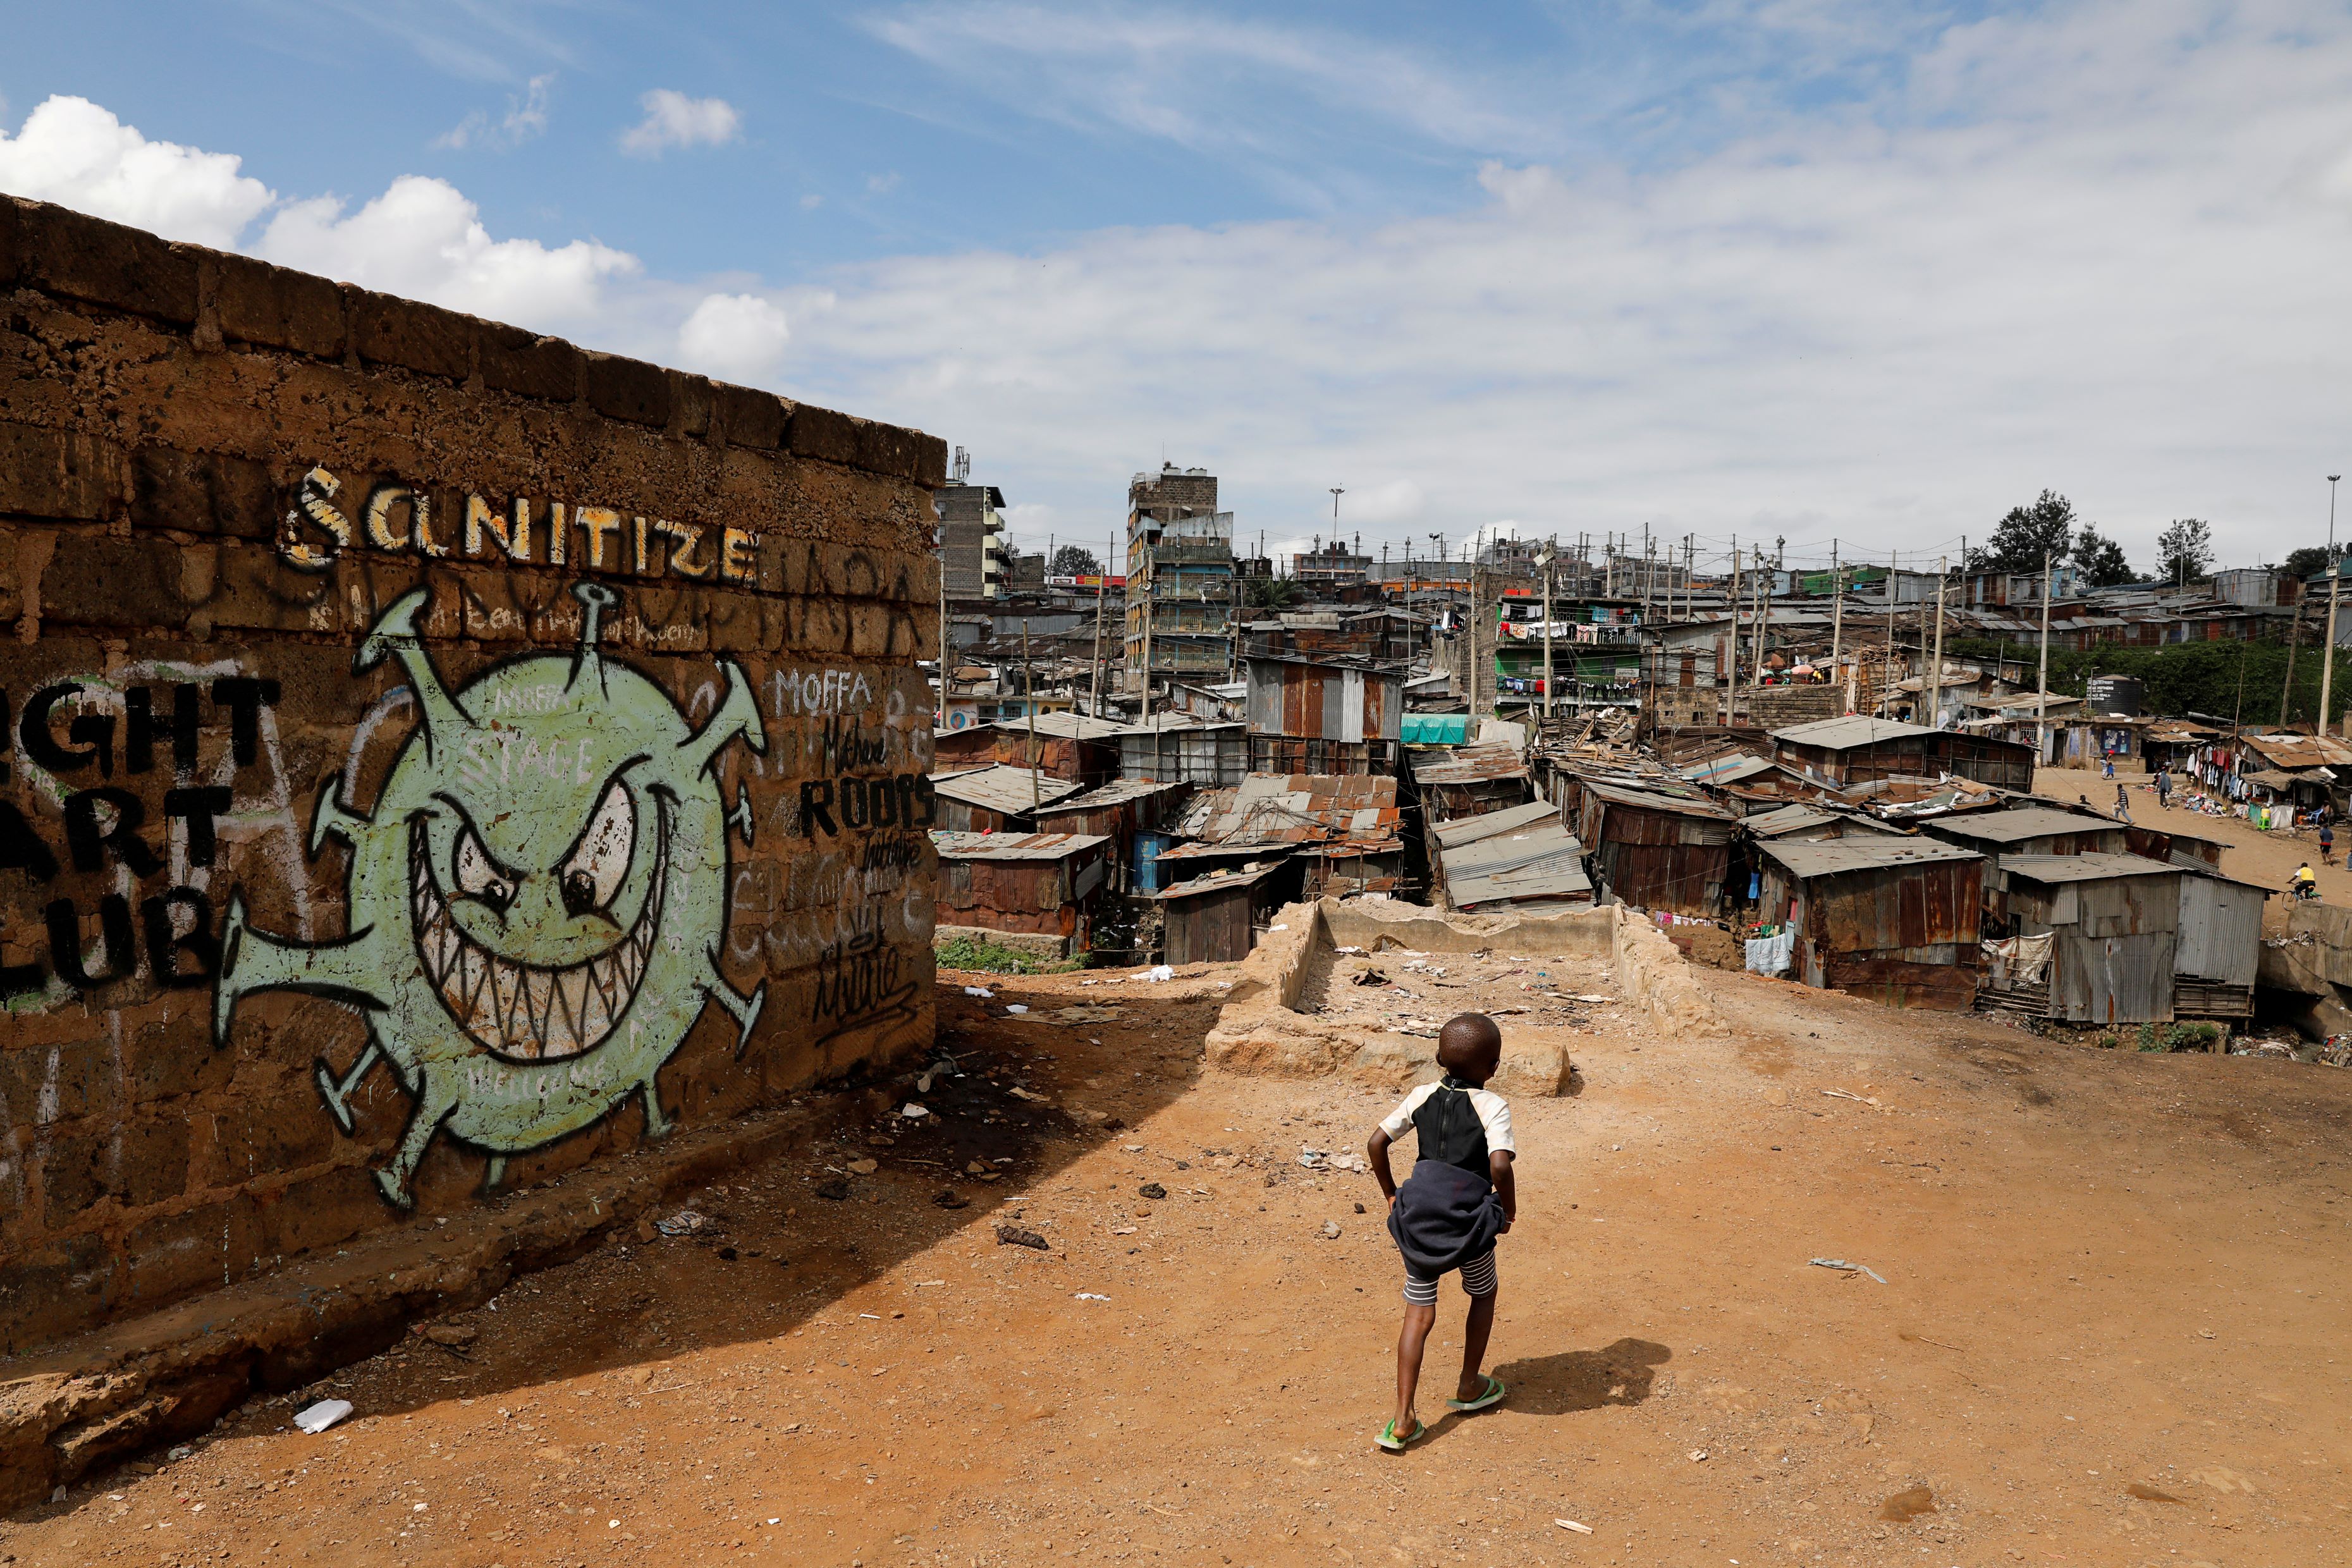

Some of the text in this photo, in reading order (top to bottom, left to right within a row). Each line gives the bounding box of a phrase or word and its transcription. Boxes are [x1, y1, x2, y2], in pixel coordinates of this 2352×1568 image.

[775, 668, 872, 718] MOFFA
[0, 678, 280, 783] GHT
[800, 772, 935, 837] ROOTS
